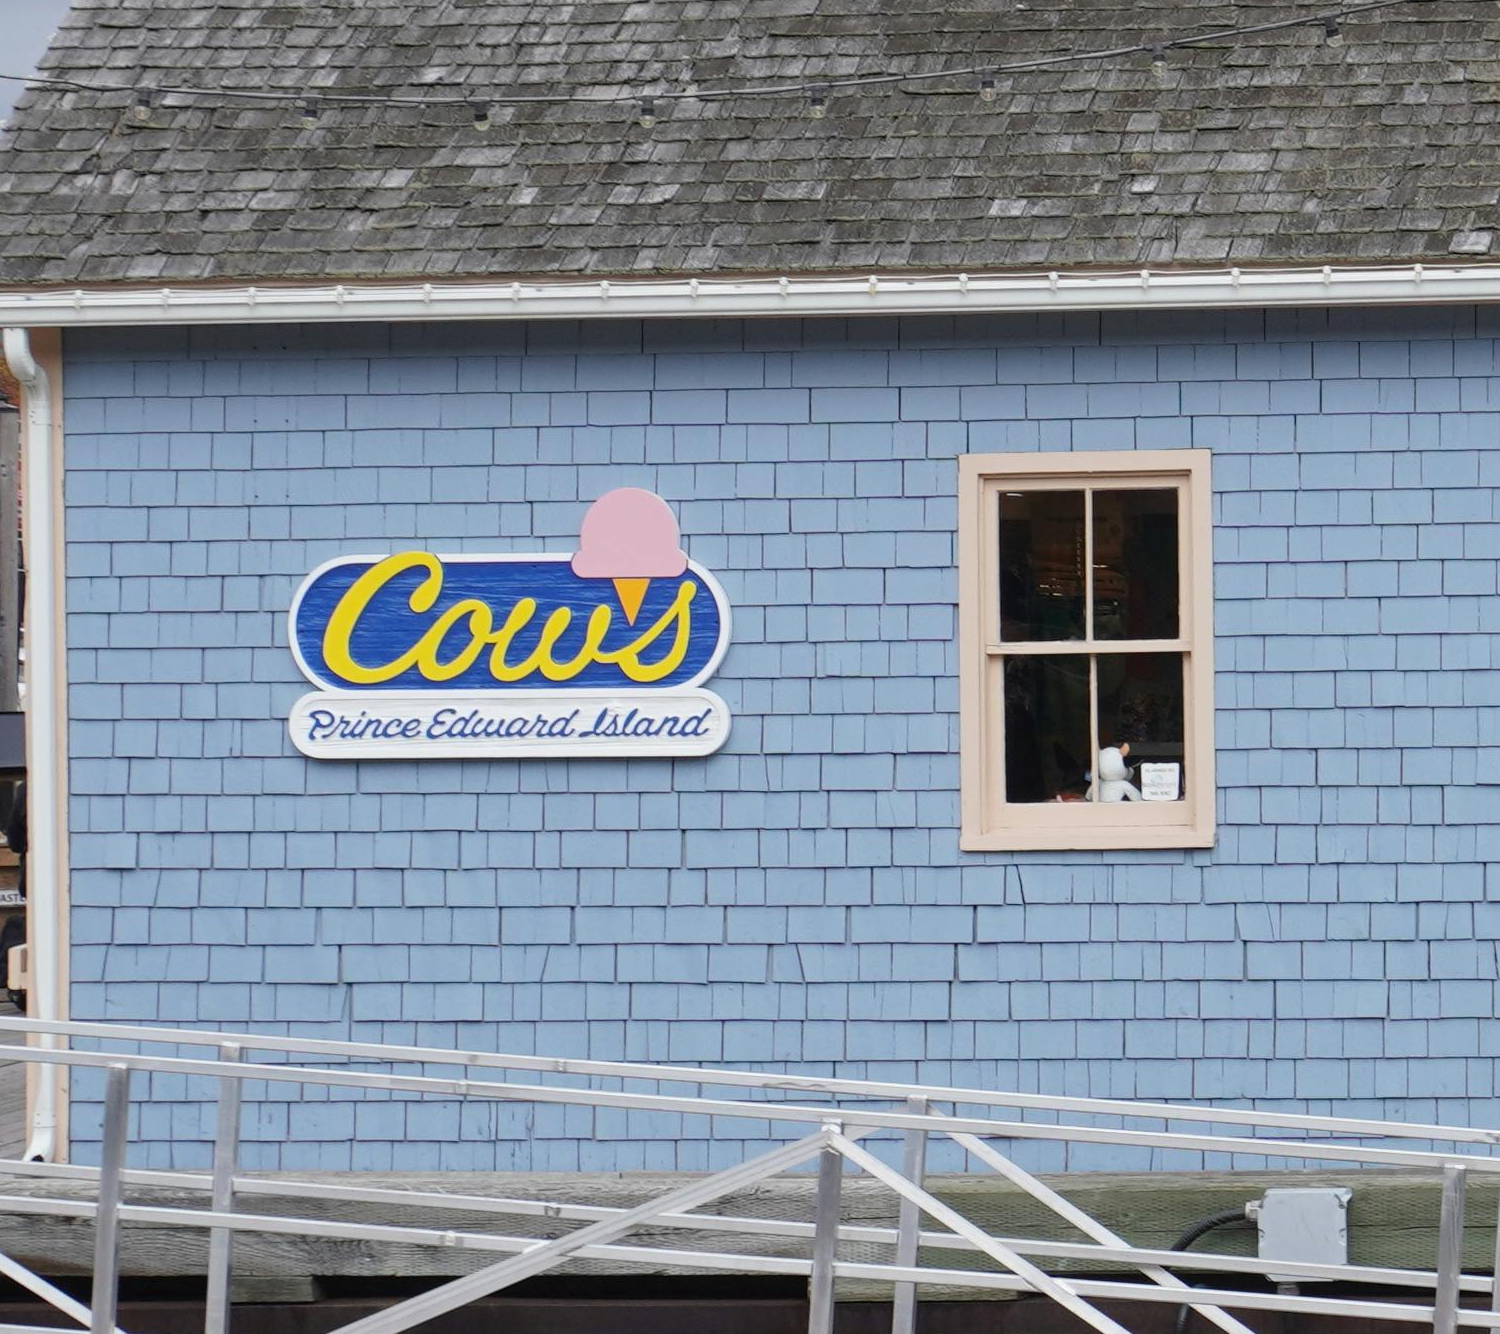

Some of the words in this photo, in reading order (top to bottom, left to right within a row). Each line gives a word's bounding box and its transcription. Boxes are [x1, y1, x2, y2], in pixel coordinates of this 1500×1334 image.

[307, 710, 421, 741] Prince
[426, 708, 580, 740] Edward
[578, 707, 713, 740] Island
